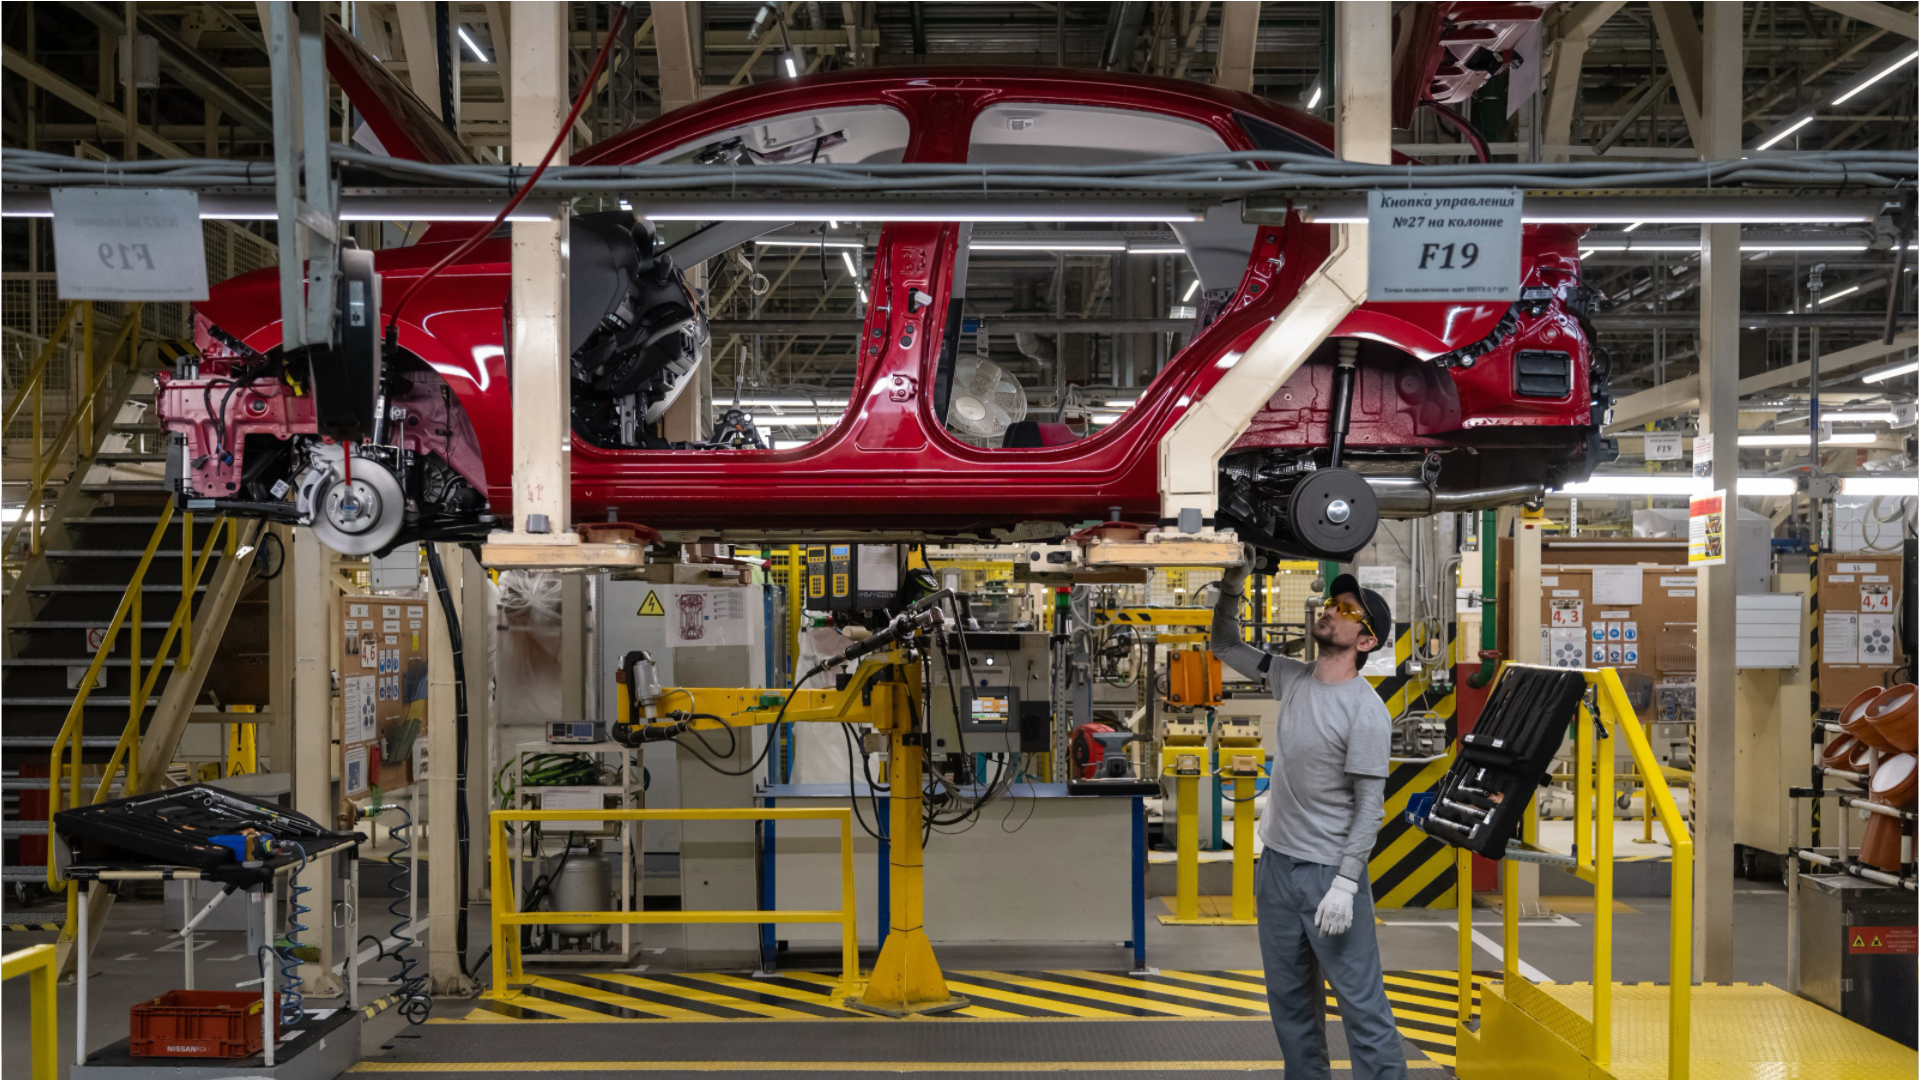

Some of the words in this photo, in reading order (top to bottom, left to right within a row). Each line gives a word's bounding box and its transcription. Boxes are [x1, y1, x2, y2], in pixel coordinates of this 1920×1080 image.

[1380, 197, 1432, 209] Кнопка
[1434, 197, 1515, 210] управления
[1392, 216, 1426, 228] №27
[1428, 218, 1445, 228] на
[1448, 218, 1504, 228] колонне
[1417, 242, 1479, 270] F19
[1656, 445, 1672, 453] F19
